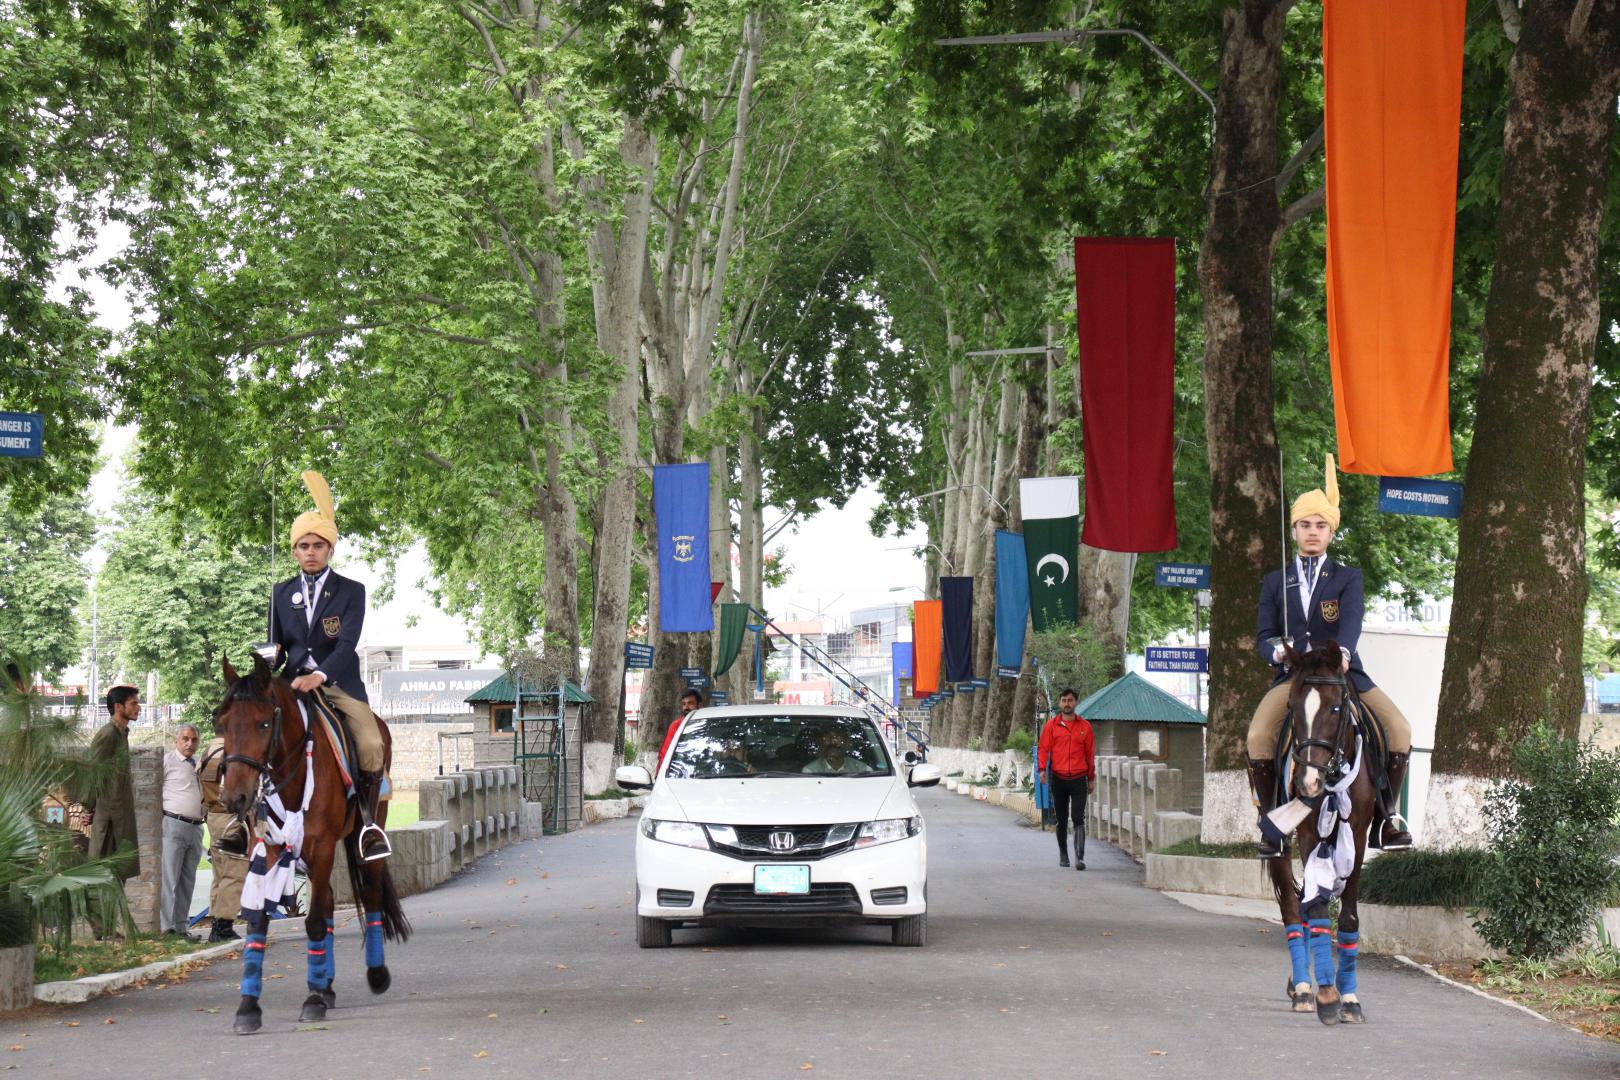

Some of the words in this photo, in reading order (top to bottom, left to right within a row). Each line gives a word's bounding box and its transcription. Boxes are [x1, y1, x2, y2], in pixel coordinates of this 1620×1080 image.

[24, 421, 31, 432] IS
[1387, 489, 1402, 499] HOPE
[1403, 491, 1422, 501] COSTS
[1423, 494, 1449, 504] NOTHING
[1385, 605, 1441, 622] SHDI
[1151, 650, 1156, 658] IT
[1157, 650, 1162, 659] IS
[1162, 650, 1181, 659] BETTER
[1181, 651, 1189, 659] TO
[1189, 651, 1196, 660] BE
[1148, 661, 1169, 670] FAITHFUL
[1169, 662, 1181, 670] THAN
[1181, 661, 1200, 671] FAMOUS
[400, 681, 446, 692] AHMAD
